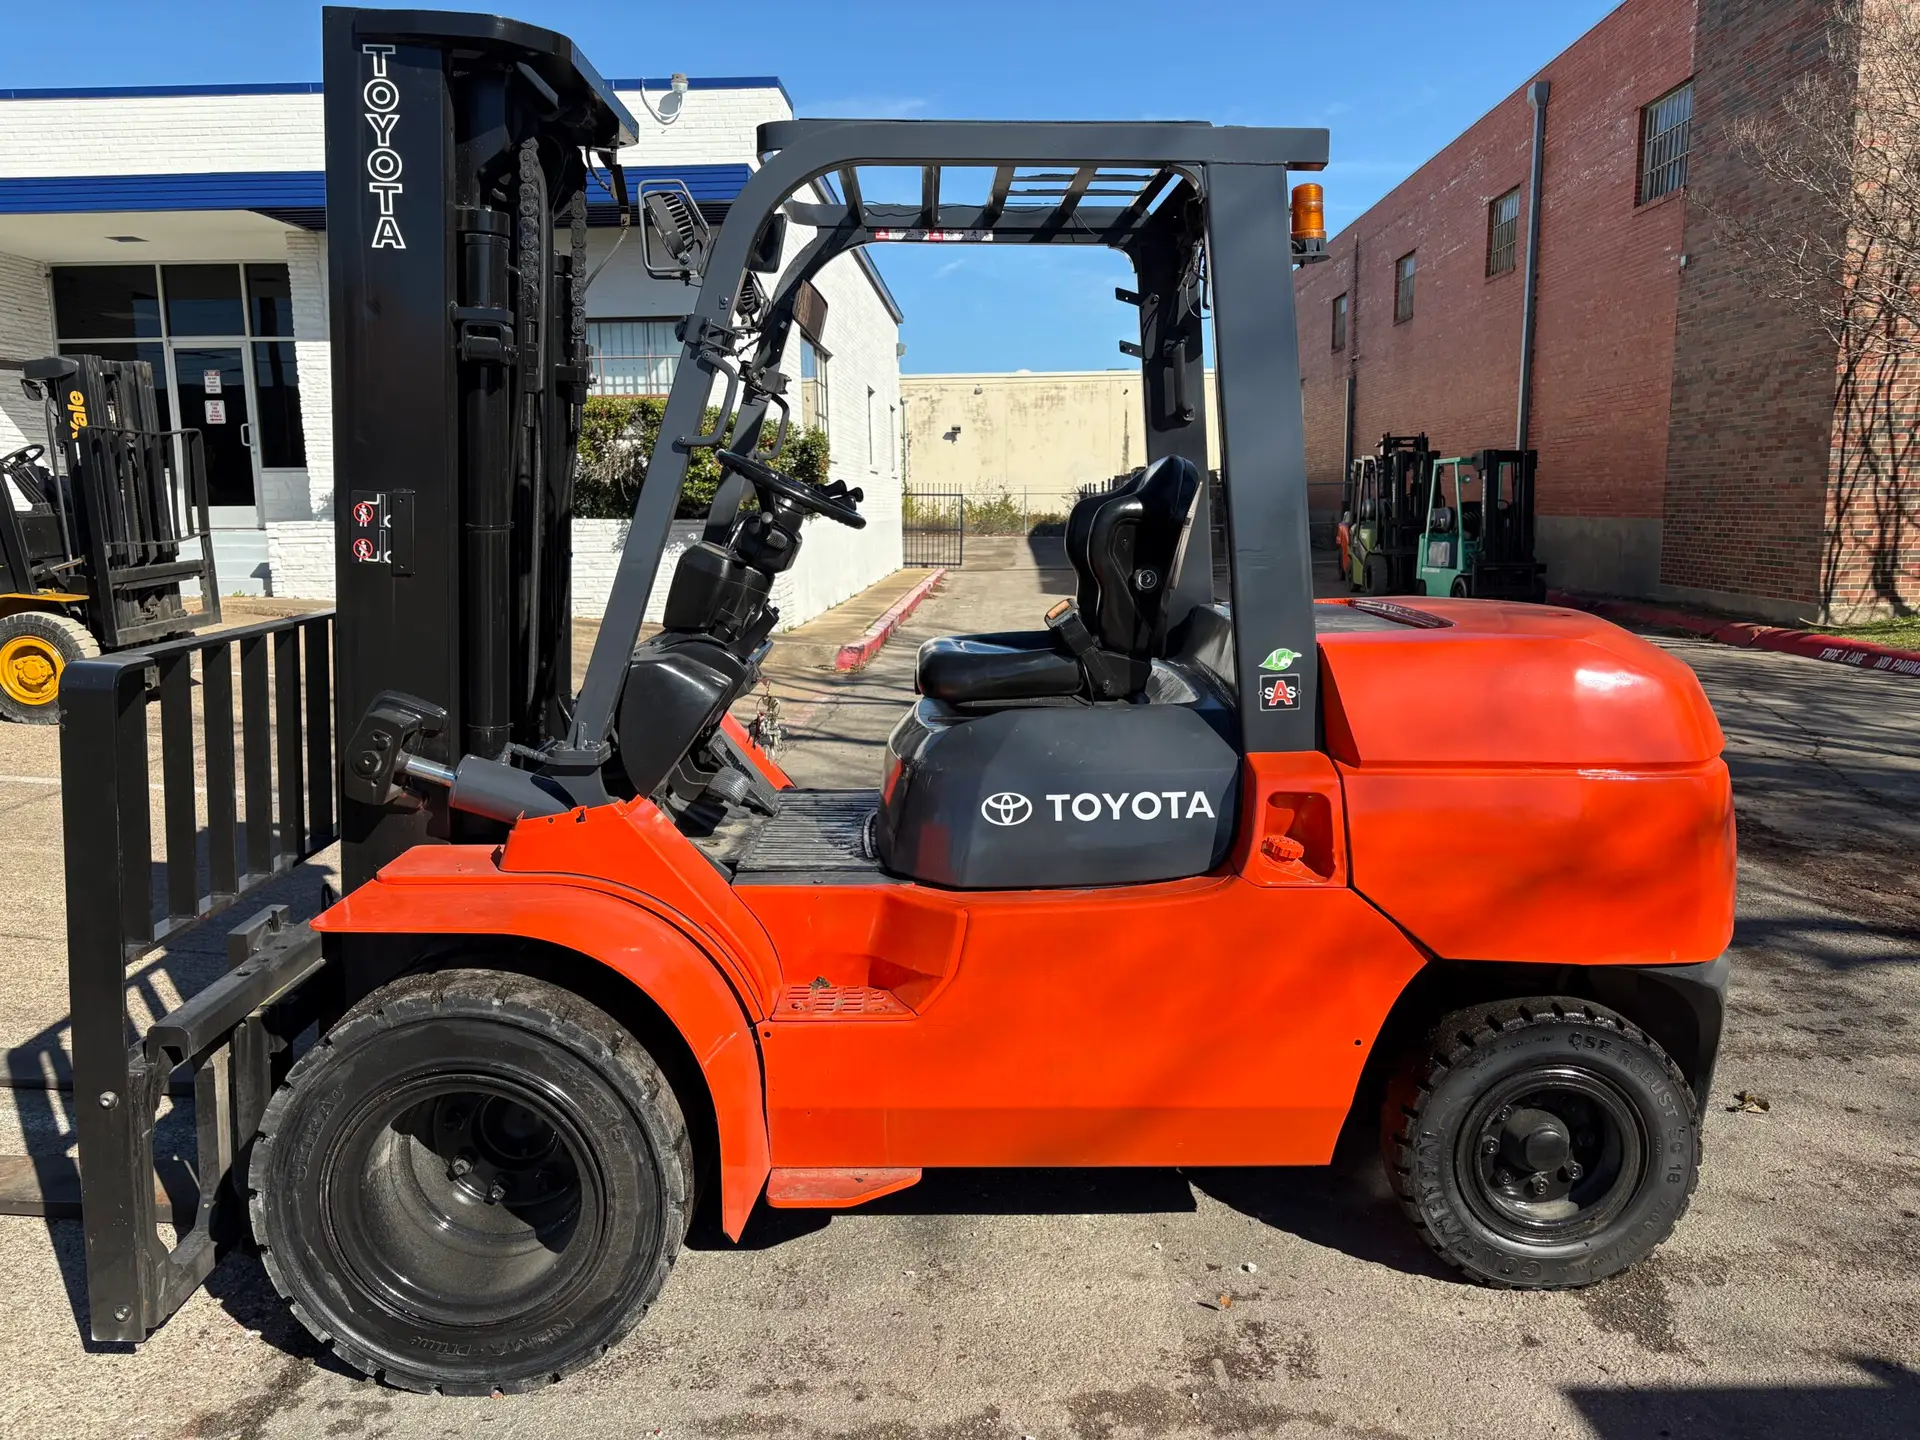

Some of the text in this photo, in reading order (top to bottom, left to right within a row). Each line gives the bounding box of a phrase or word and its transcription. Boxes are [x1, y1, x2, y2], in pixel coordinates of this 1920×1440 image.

[362, 44, 406, 249] TOYOTA
[1818, 647, 1843, 661] FIRE
[1840, 650, 1868, 665] LANE
[1873, 656, 1893, 669] NO
[1264, 680, 1297, 706] SAS
[1046, 791, 1215, 822] TOYOTA
